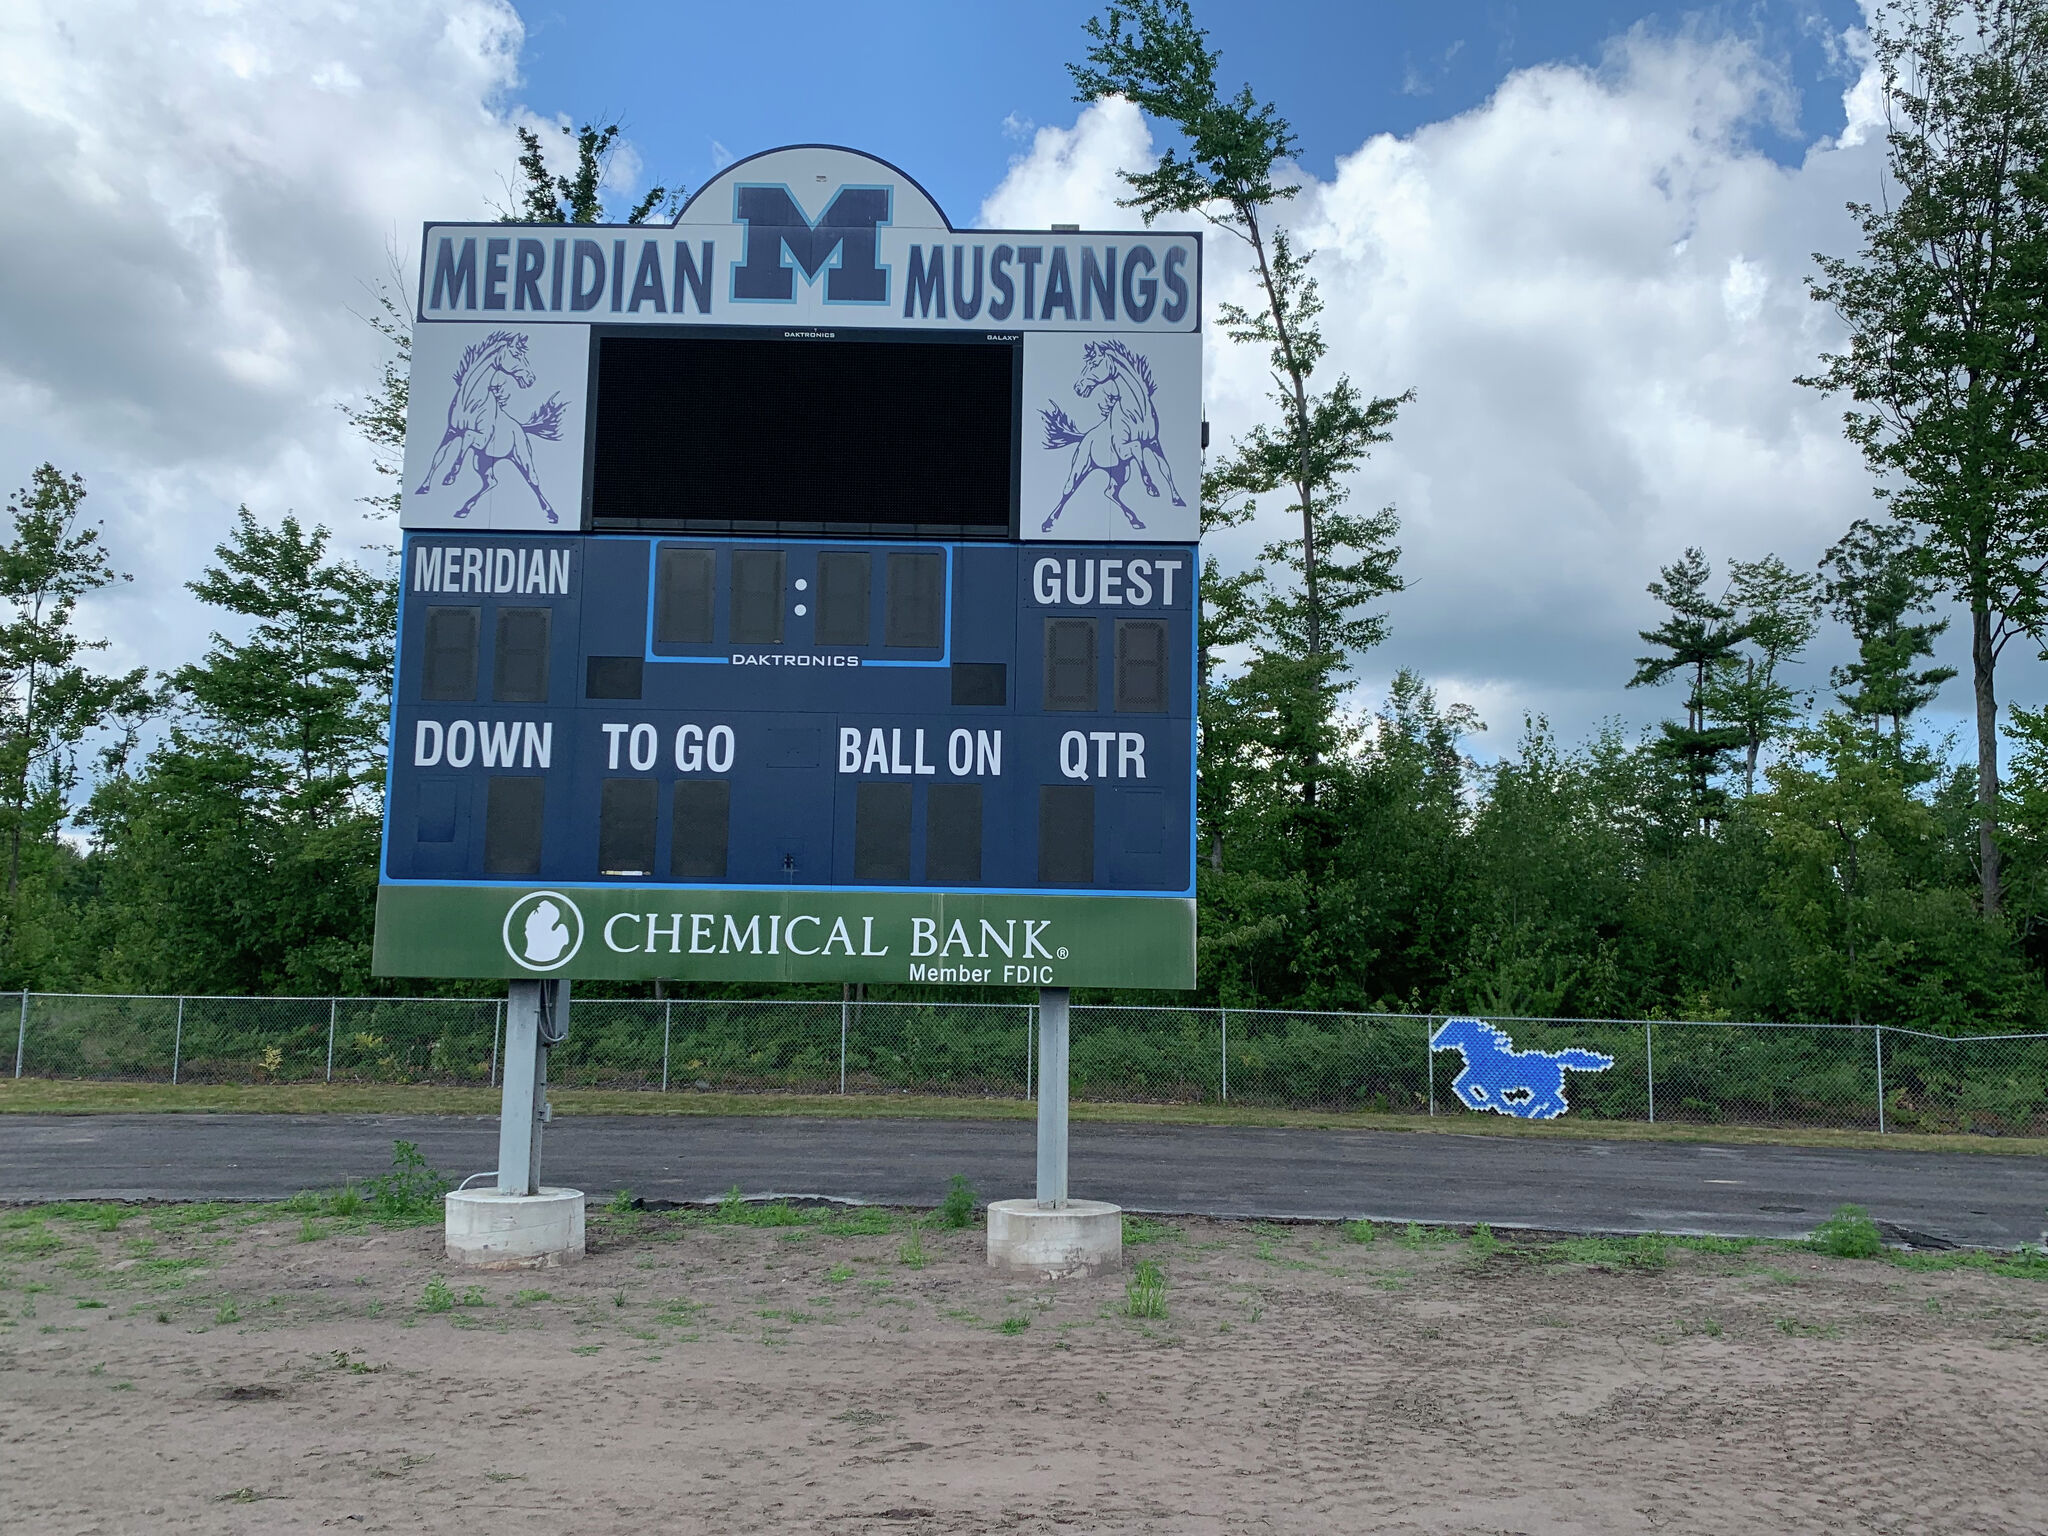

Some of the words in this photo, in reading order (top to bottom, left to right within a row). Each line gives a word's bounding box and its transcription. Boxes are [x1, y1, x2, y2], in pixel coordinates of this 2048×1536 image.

[429, 236, 715, 316] MERIDIAN
[729, 182, 894, 306] M
[902, 243, 1190, 324] MUSTANGS
[413, 546, 571, 595] MERIDIAN
[1032, 557, 1183, 606] GUEST
[732, 654, 859, 667] DAKTRONICS
[414, 719, 553, 769] DOWN
[602, 723, 658, 771] TO
[675, 724, 735, 773] GO
[838, 726, 936, 775] BALL
[948, 727, 1002, 777] ON
[1059, 730, 1147, 782] QTR
[603, 912, 889, 958] CHEMICAL
[908, 963, 992, 983] Member
[1003, 965, 1054, 984] FDIC
